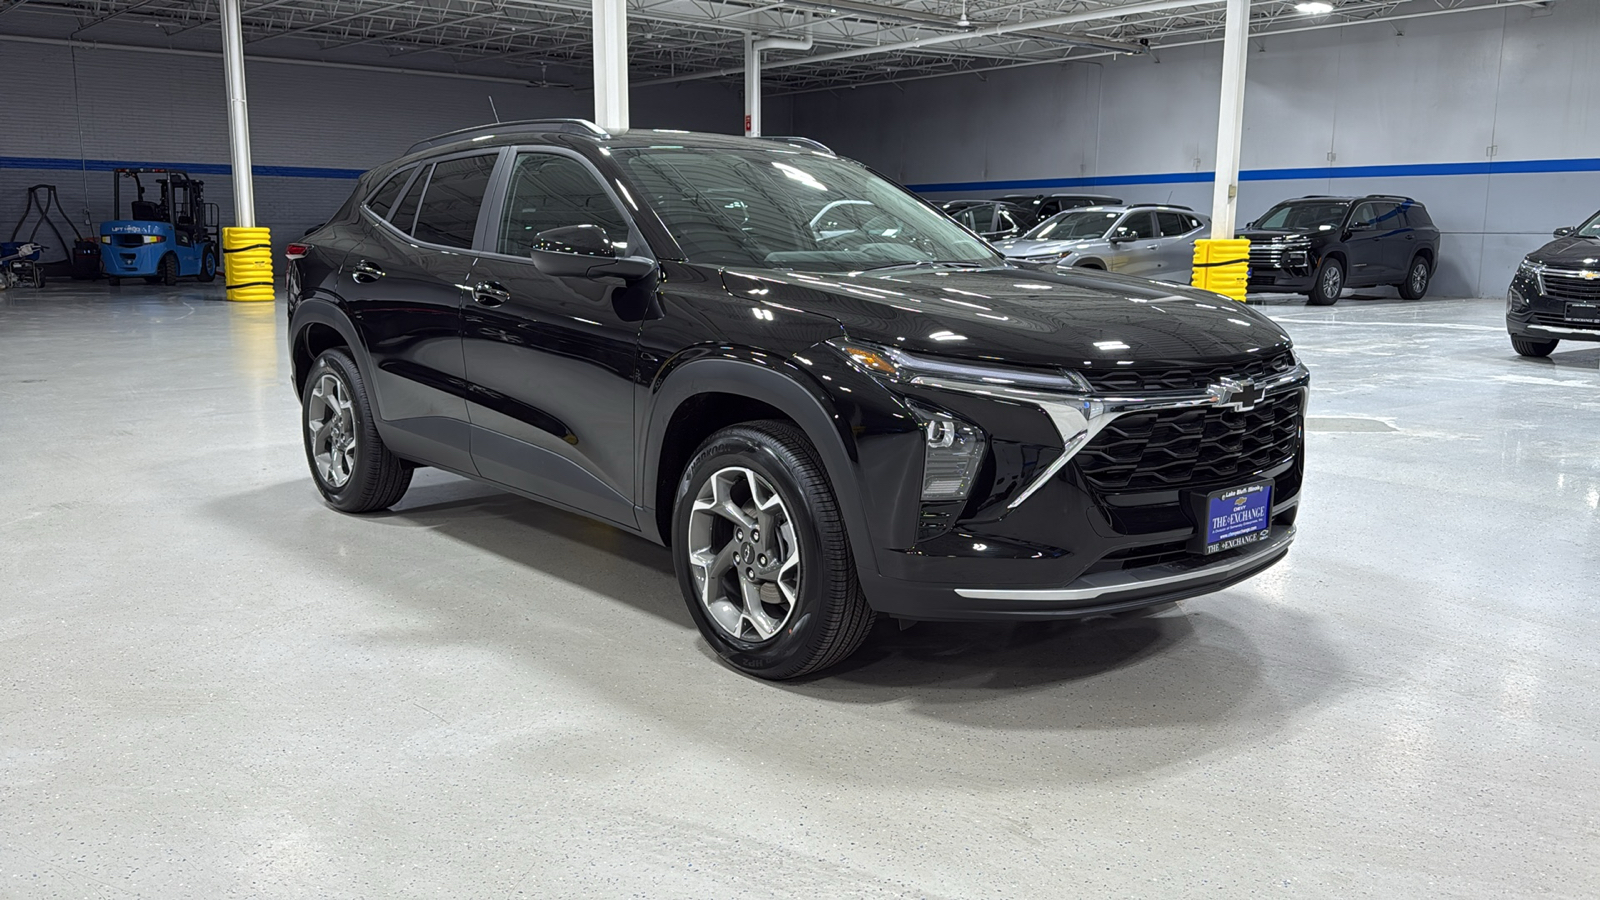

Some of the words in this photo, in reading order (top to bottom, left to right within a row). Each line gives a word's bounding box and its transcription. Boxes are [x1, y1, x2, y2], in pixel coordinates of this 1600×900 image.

[1212, 515, 1228, 529] THE
[1230, 506, 1265, 525] EXCHANGE
[1207, 543, 1220, 553] THE
[1224, 533, 1258, 549] EXCHANGE
